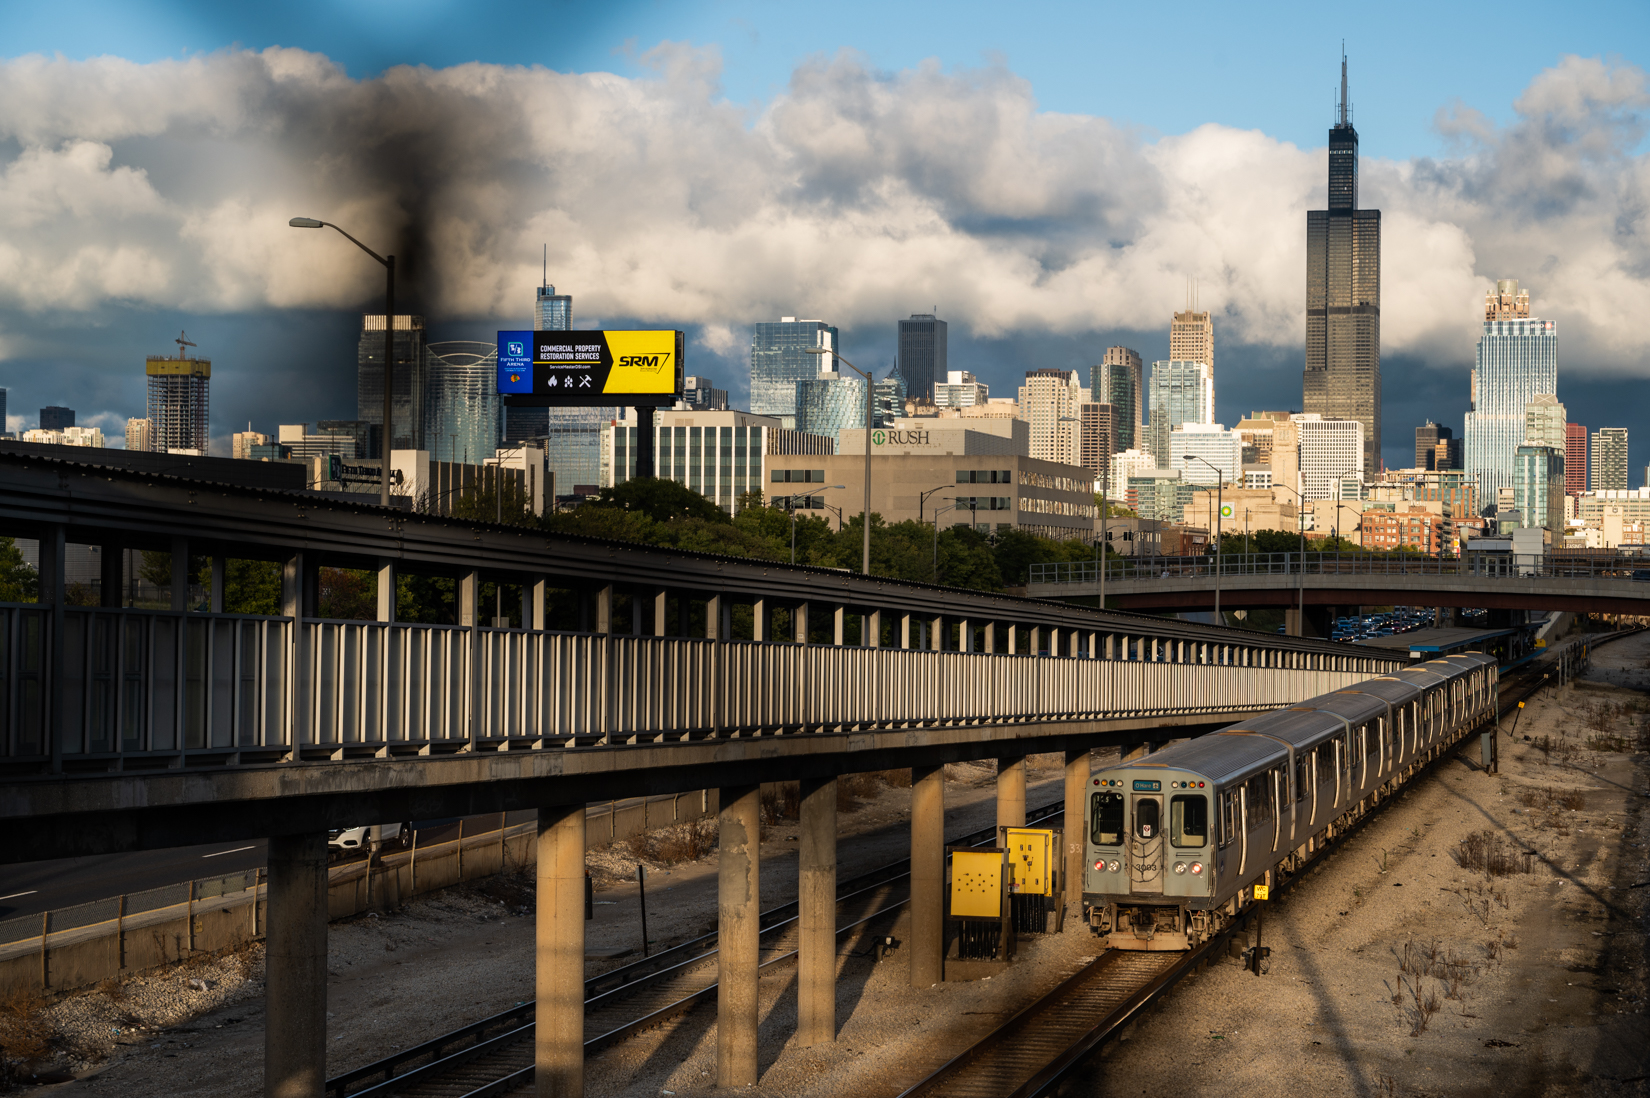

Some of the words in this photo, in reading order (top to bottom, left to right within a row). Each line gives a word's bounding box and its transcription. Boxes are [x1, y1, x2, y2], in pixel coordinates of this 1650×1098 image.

[540, 352, 574, 360] RESTORATION
[575, 352, 600, 360] SERVICES
[619, 356, 659, 367] SRM
[888, 431, 929, 444] RUSH
